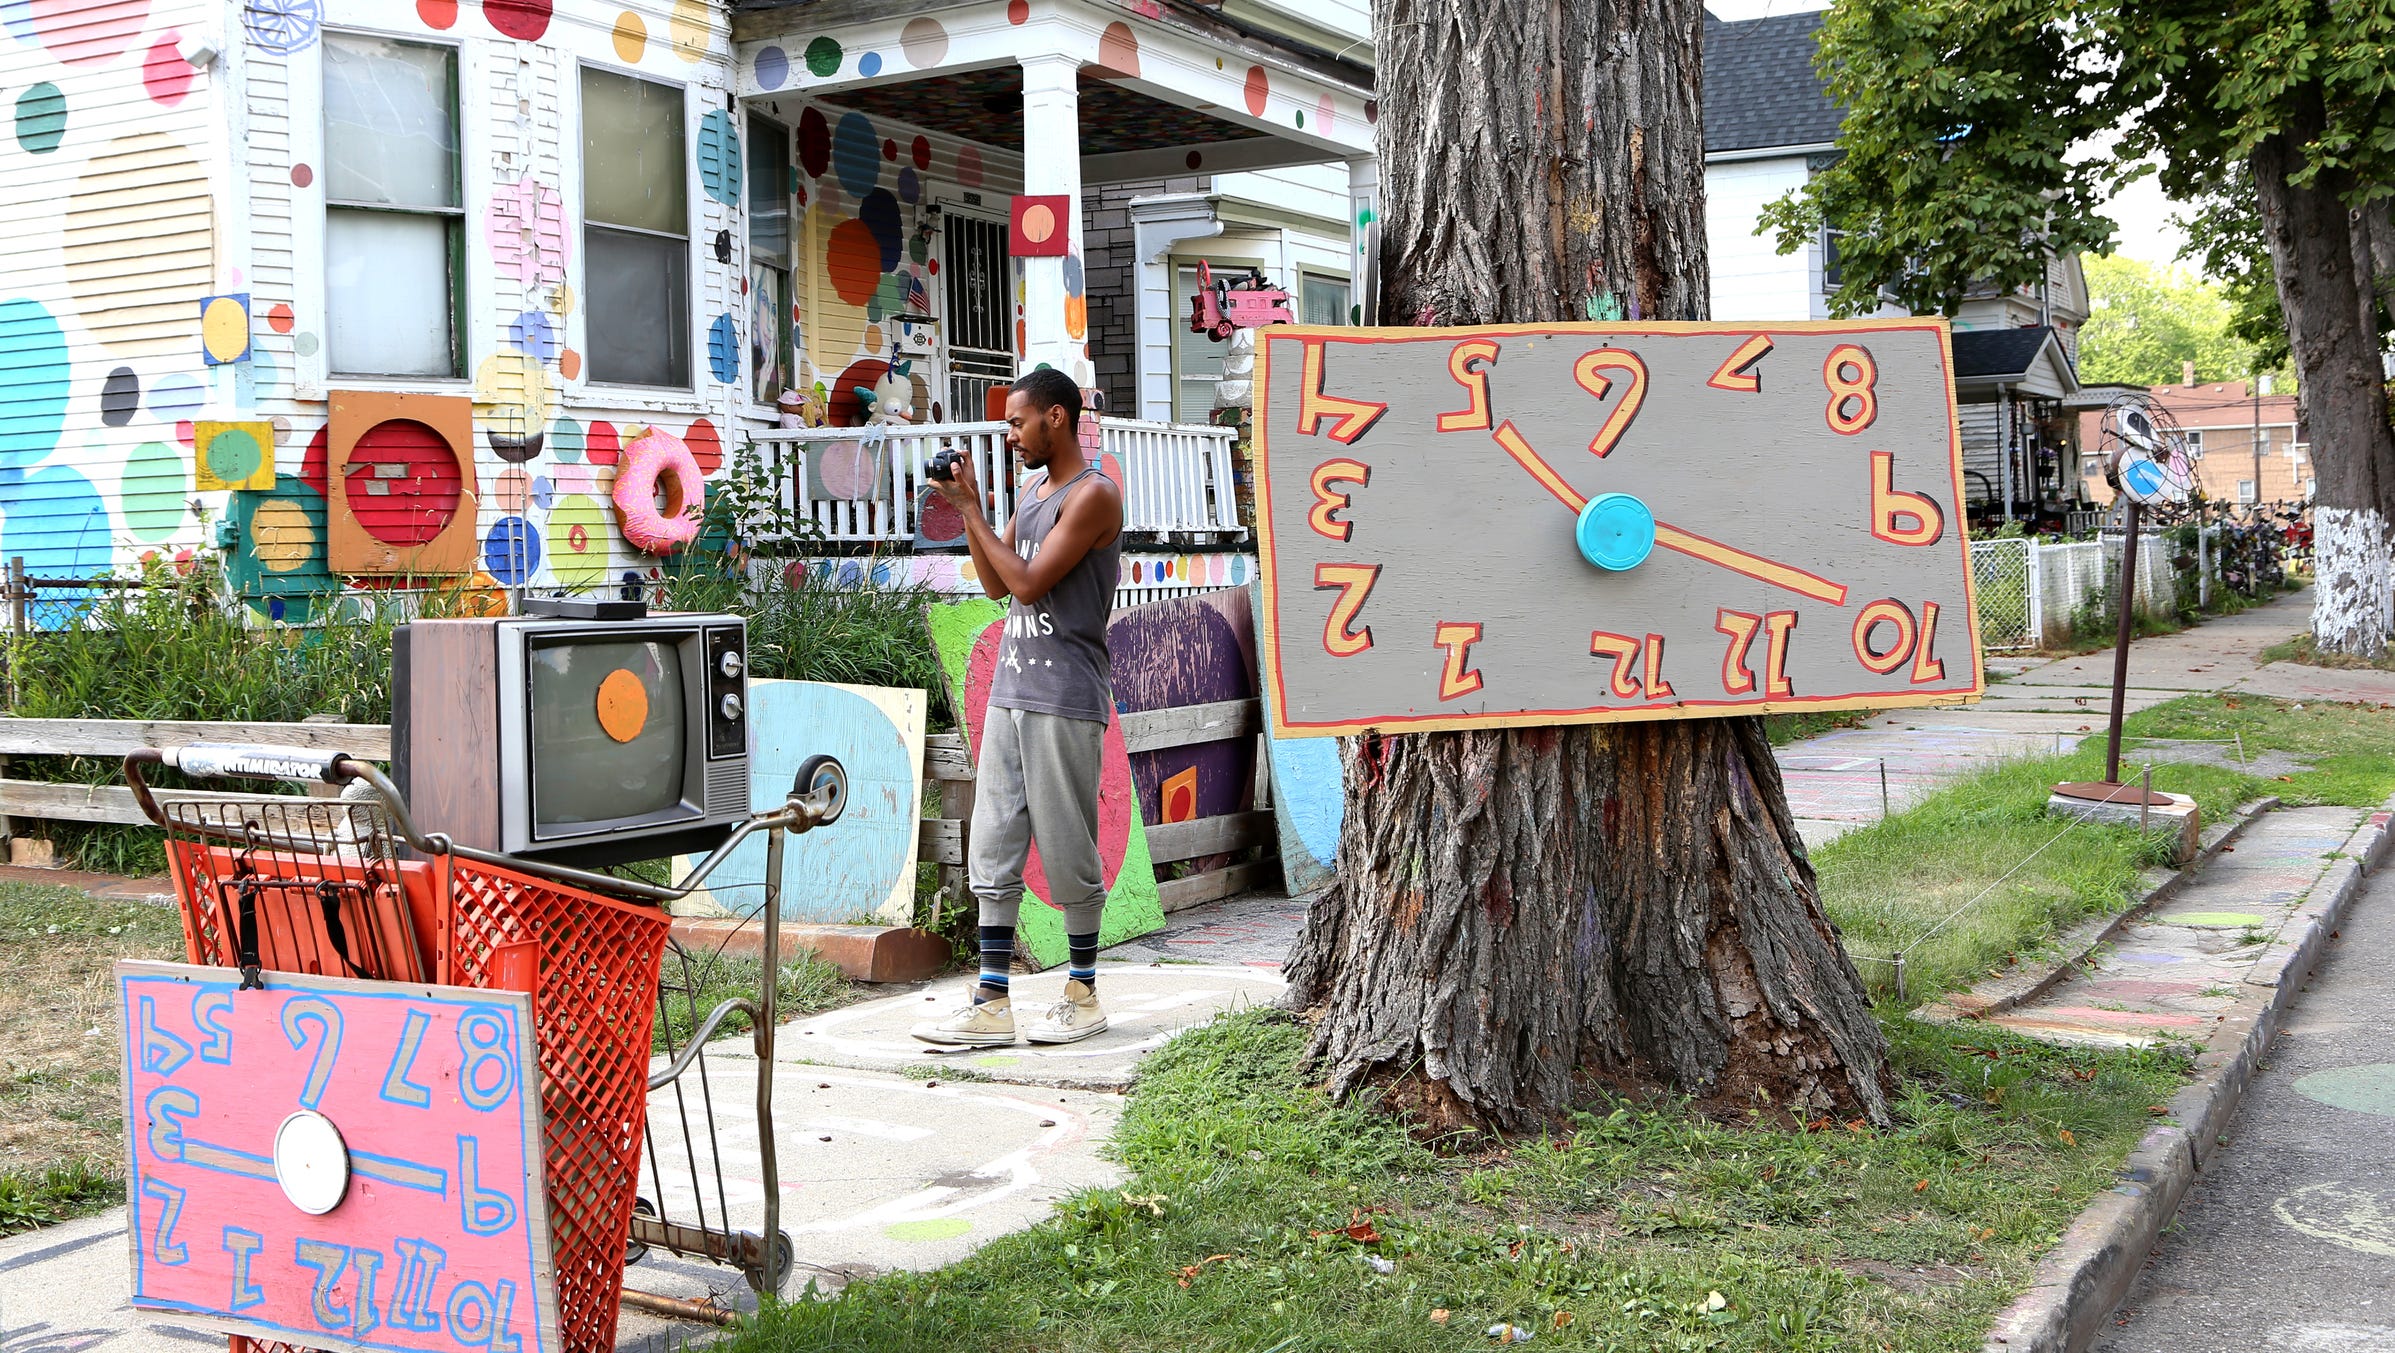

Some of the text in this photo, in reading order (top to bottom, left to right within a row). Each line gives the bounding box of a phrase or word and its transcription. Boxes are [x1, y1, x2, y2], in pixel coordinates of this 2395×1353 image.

[1297, 339, 1387, 444] 4
[1437, 339, 1501, 432] 5
[1573, 348, 1650, 458] 6
[1708, 334, 1774, 393] 7
[1823, 343, 1879, 435] 8
[1308, 458, 1371, 542] 3
[1869, 451, 1945, 546] 9
[1314, 563, 1383, 657] 2
[1852, 598, 1946, 684] 10
[1434, 621, 1484, 701] 1
[219, 757, 322, 779] NTIMIDATOR
[140, 995, 194, 1076] 4
[192, 984, 233, 1065] 5
[281, 995, 344, 1109] 6
[380, 1008, 431, 1108] 7
[457, 1007, 515, 1111] 8
[145, 1085, 200, 1163] 3
[142, 1175, 189, 1265] 2
[457, 1133, 517, 1236] 9
[223, 1226, 265, 1312] 1
[296, 1237, 383, 1339] 12
[388, 1237, 446, 1332] 11
[447, 1279, 522, 1353] 10
